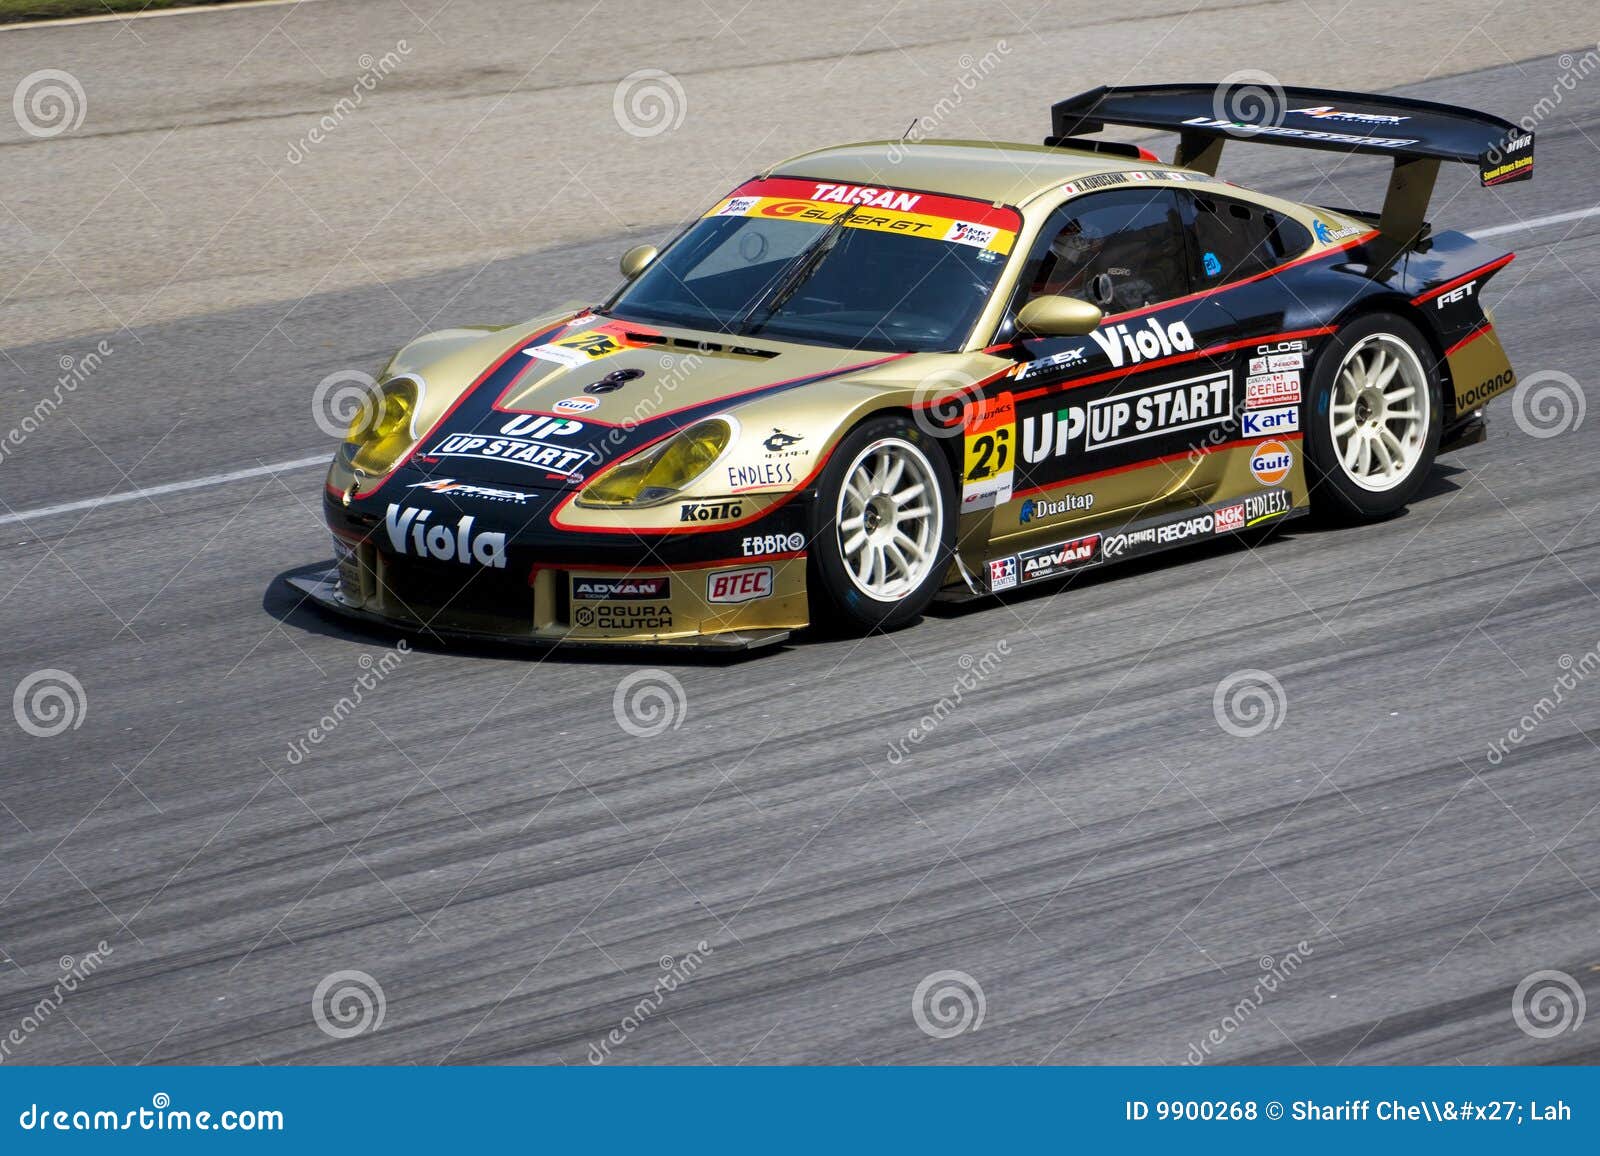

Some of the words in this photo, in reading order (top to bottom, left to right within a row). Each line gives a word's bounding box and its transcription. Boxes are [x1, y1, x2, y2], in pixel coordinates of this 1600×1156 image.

[810, 183, 921, 212] TAISAN
[889, 220, 932, 233] GT
[1437, 280, 1477, 310] FET
[1089, 318, 1194, 367] Viola
[1247, 381, 1298, 397] ICEFIELD
[1456, 369, 1514, 410] VOLCANO
[557, 400, 595, 410] Gulf
[1023, 406, 1085, 463] UP
[1091, 397, 1129, 443] UP
[1135, 379, 1229, 432] START
[1243, 409, 1297, 433] Kart
[442, 436, 484, 454] UP
[483, 438, 581, 470] START
[1252, 455, 1291, 473] Gulf
[728, 463, 794, 487] ENDLESS
[1035, 493, 1095, 519] Dualtap
[1216, 506, 1243, 527] NGK
[1245, 489, 1289, 519] ENDLESS
[385, 503, 508, 569] Viola
[1157, 515, 1214, 544] RECARO
[741, 532, 805, 556] EBBRO
[1025, 545, 1092, 572] ADVAN
[577, 584, 656, 593] ADVAN
[712, 570, 768, 598] BTEC
[597, 605, 672, 616] OGURA
[598, 617, 672, 629] CLUTCH
